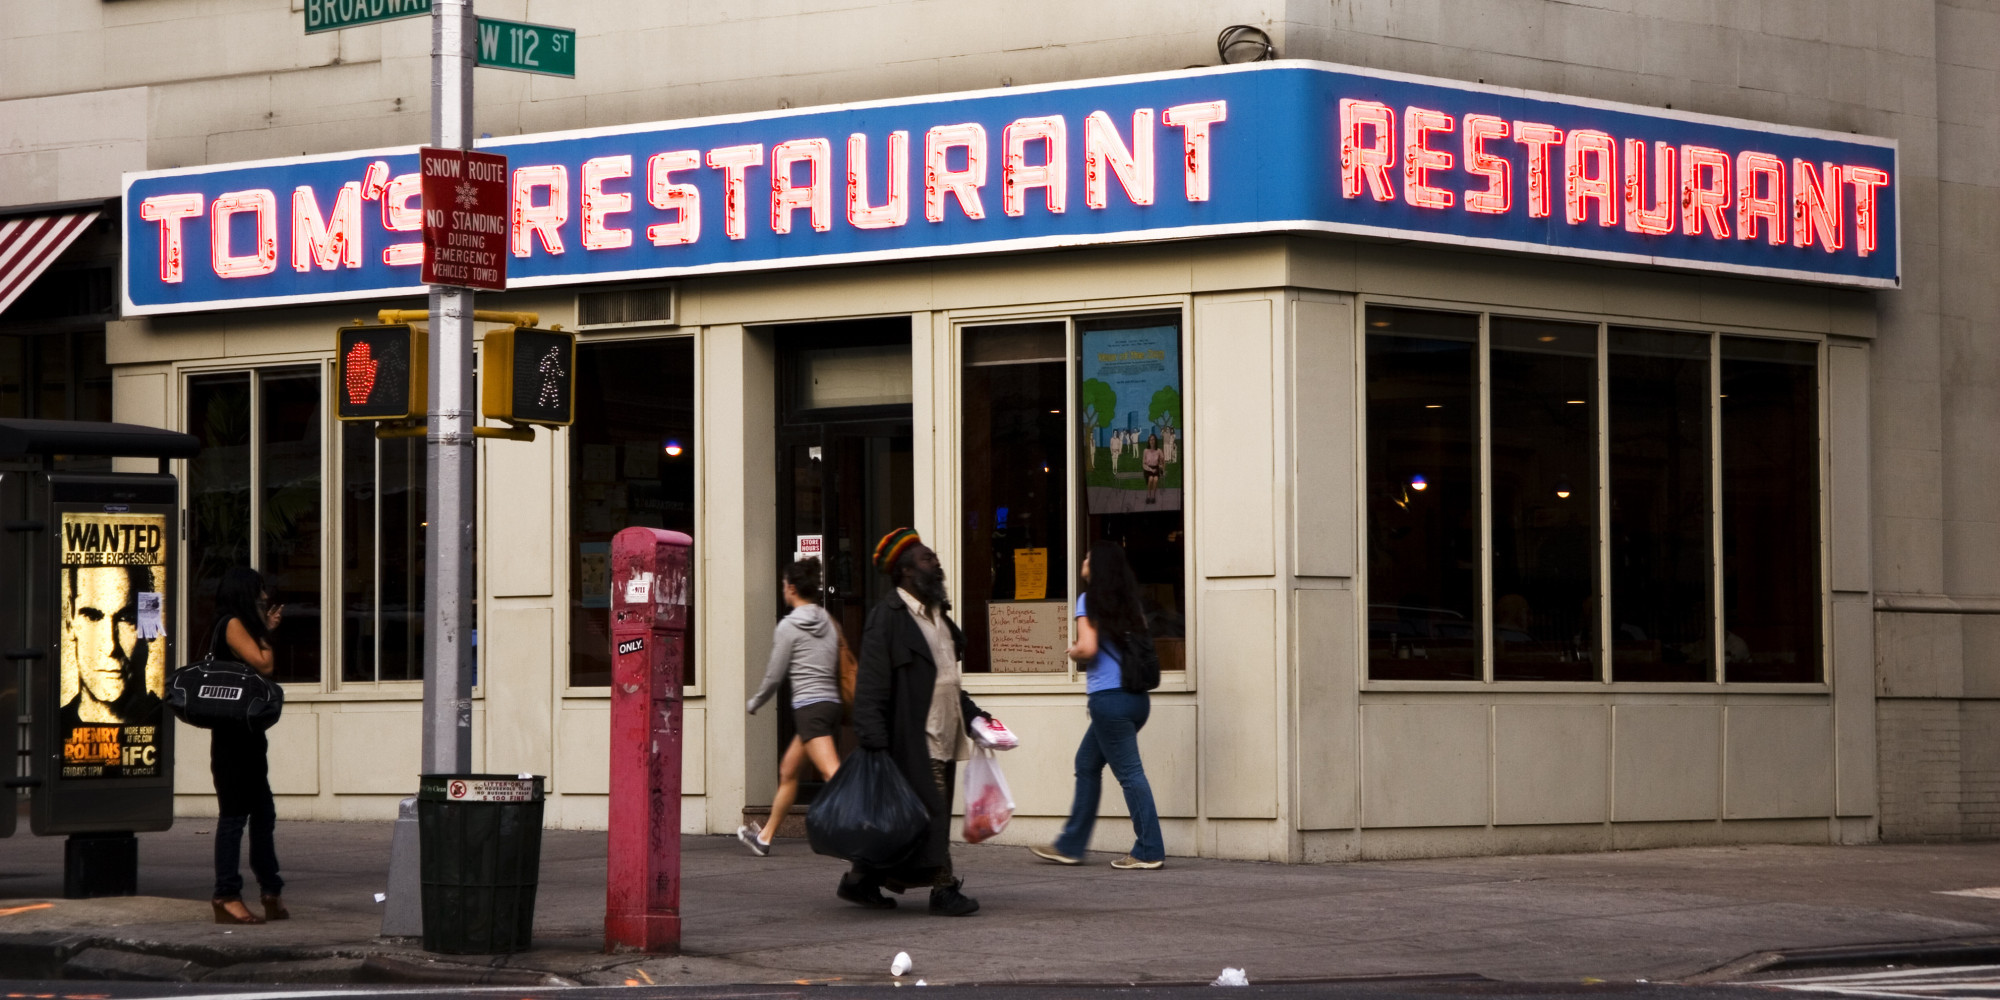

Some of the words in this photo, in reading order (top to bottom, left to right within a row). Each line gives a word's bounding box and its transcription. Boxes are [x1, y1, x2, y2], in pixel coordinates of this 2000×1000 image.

[309, 0, 427, 27] BROAD
[480, 23, 500, 61] W
[510, 28, 539, 67] 112
[552, 33, 569, 53] ST
[425, 157, 461, 178] SNOW
[468, 161, 504, 183] ROUTE
[1339, 97, 1889, 258] RESTAURANT
[141, 161, 423, 284] TOM'S
[511, 100, 1227, 259] RESTAURANT
[427, 209, 444, 228] NO
[452, 211, 504, 235] STANDING
[448, 232, 485, 249] DURING
[435, 247, 496, 266] EMERGENCY
[432, 262, 468, 279] VEHICLES
[473, 267, 498, 282] TOWED
[65, 522, 160, 553] WANTED
[66, 553, 82, 564] FOR
[85, 553, 104, 564] FREE
[106, 552, 158, 564] EXPRESSION
[619, 640, 643, 654] ONLY.
[200, 686, 241, 699] PUMA
[72, 727, 120, 743] HENRY
[124, 726, 138, 735] MORE
[139, 726, 155, 735] HENRY
[127, 735, 132, 743] AT
[62, 766, 87, 776] FRIDAYS
[88, 766, 103, 776] 11PM
